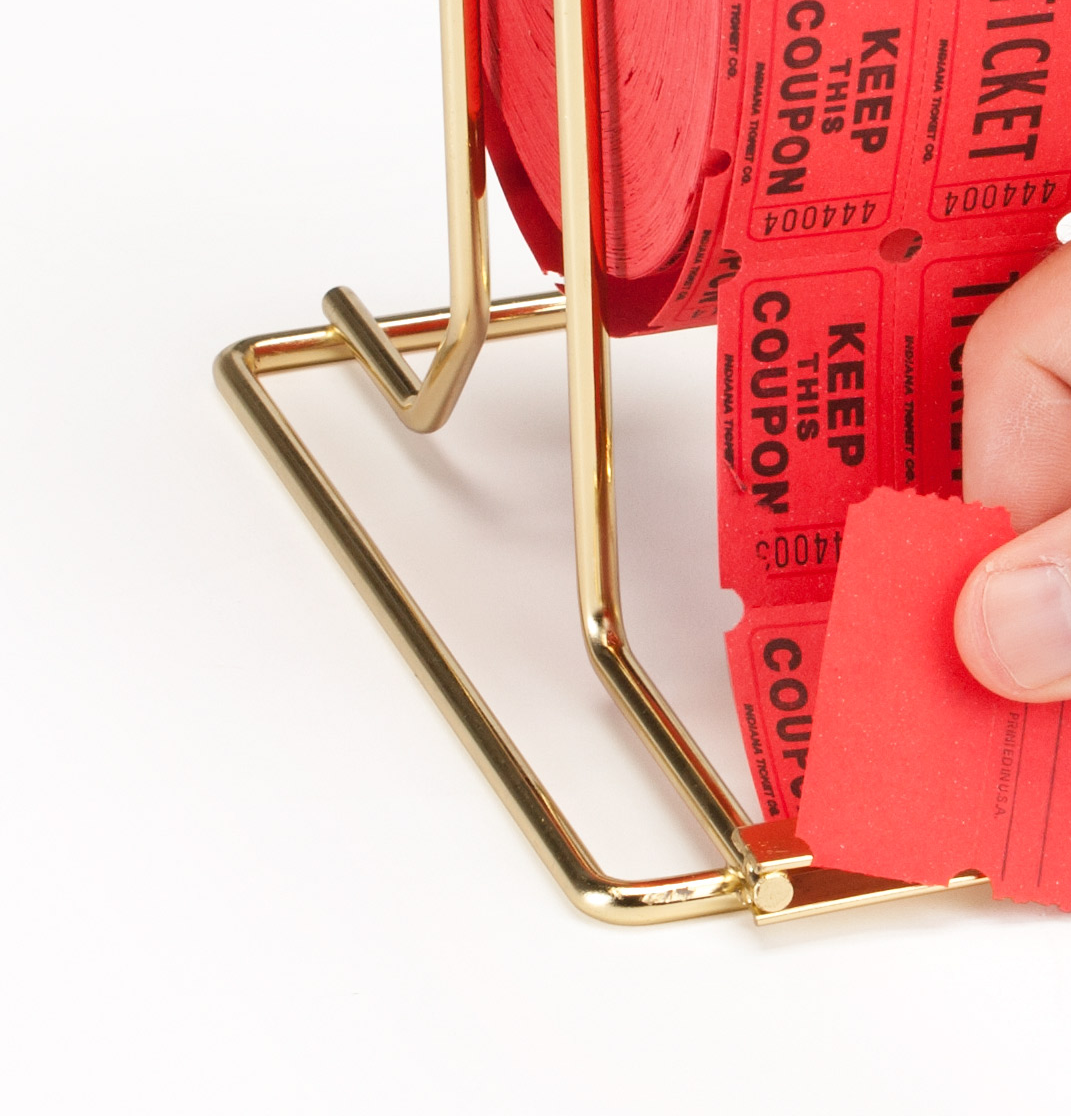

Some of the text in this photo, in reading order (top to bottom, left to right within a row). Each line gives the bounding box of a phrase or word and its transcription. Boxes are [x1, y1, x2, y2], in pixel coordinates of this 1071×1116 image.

[728, 1, 741, 54] TICKET
[749, 61, 766, 118] INDIANA
[821, 57, 851, 135] THIS
[850, 27, 900, 154] KEEP
[932, 39, 948, 93] INDIANA
[766, 0, 825, 196] COUPON
[928, 97, 942, 146] TICKET
[744, 118, 759, 165] TICKET
[764, 199, 876, 236] 444004
[944, 179, 1056, 216] 444004
[723, 353, 734, 414] INDIANA
[827, 322, 865, 467] KEEP
[904, 335, 915, 395] INDIANA
[751, 290, 791, 515] COUPON
[796, 352, 820, 442] THIS
[904, 401, 915, 455] TICKET
[743, 704, 763, 754] INDIANA
[755, 758, 775, 798] TICKET
[763, 638, 812, 811] COUP
